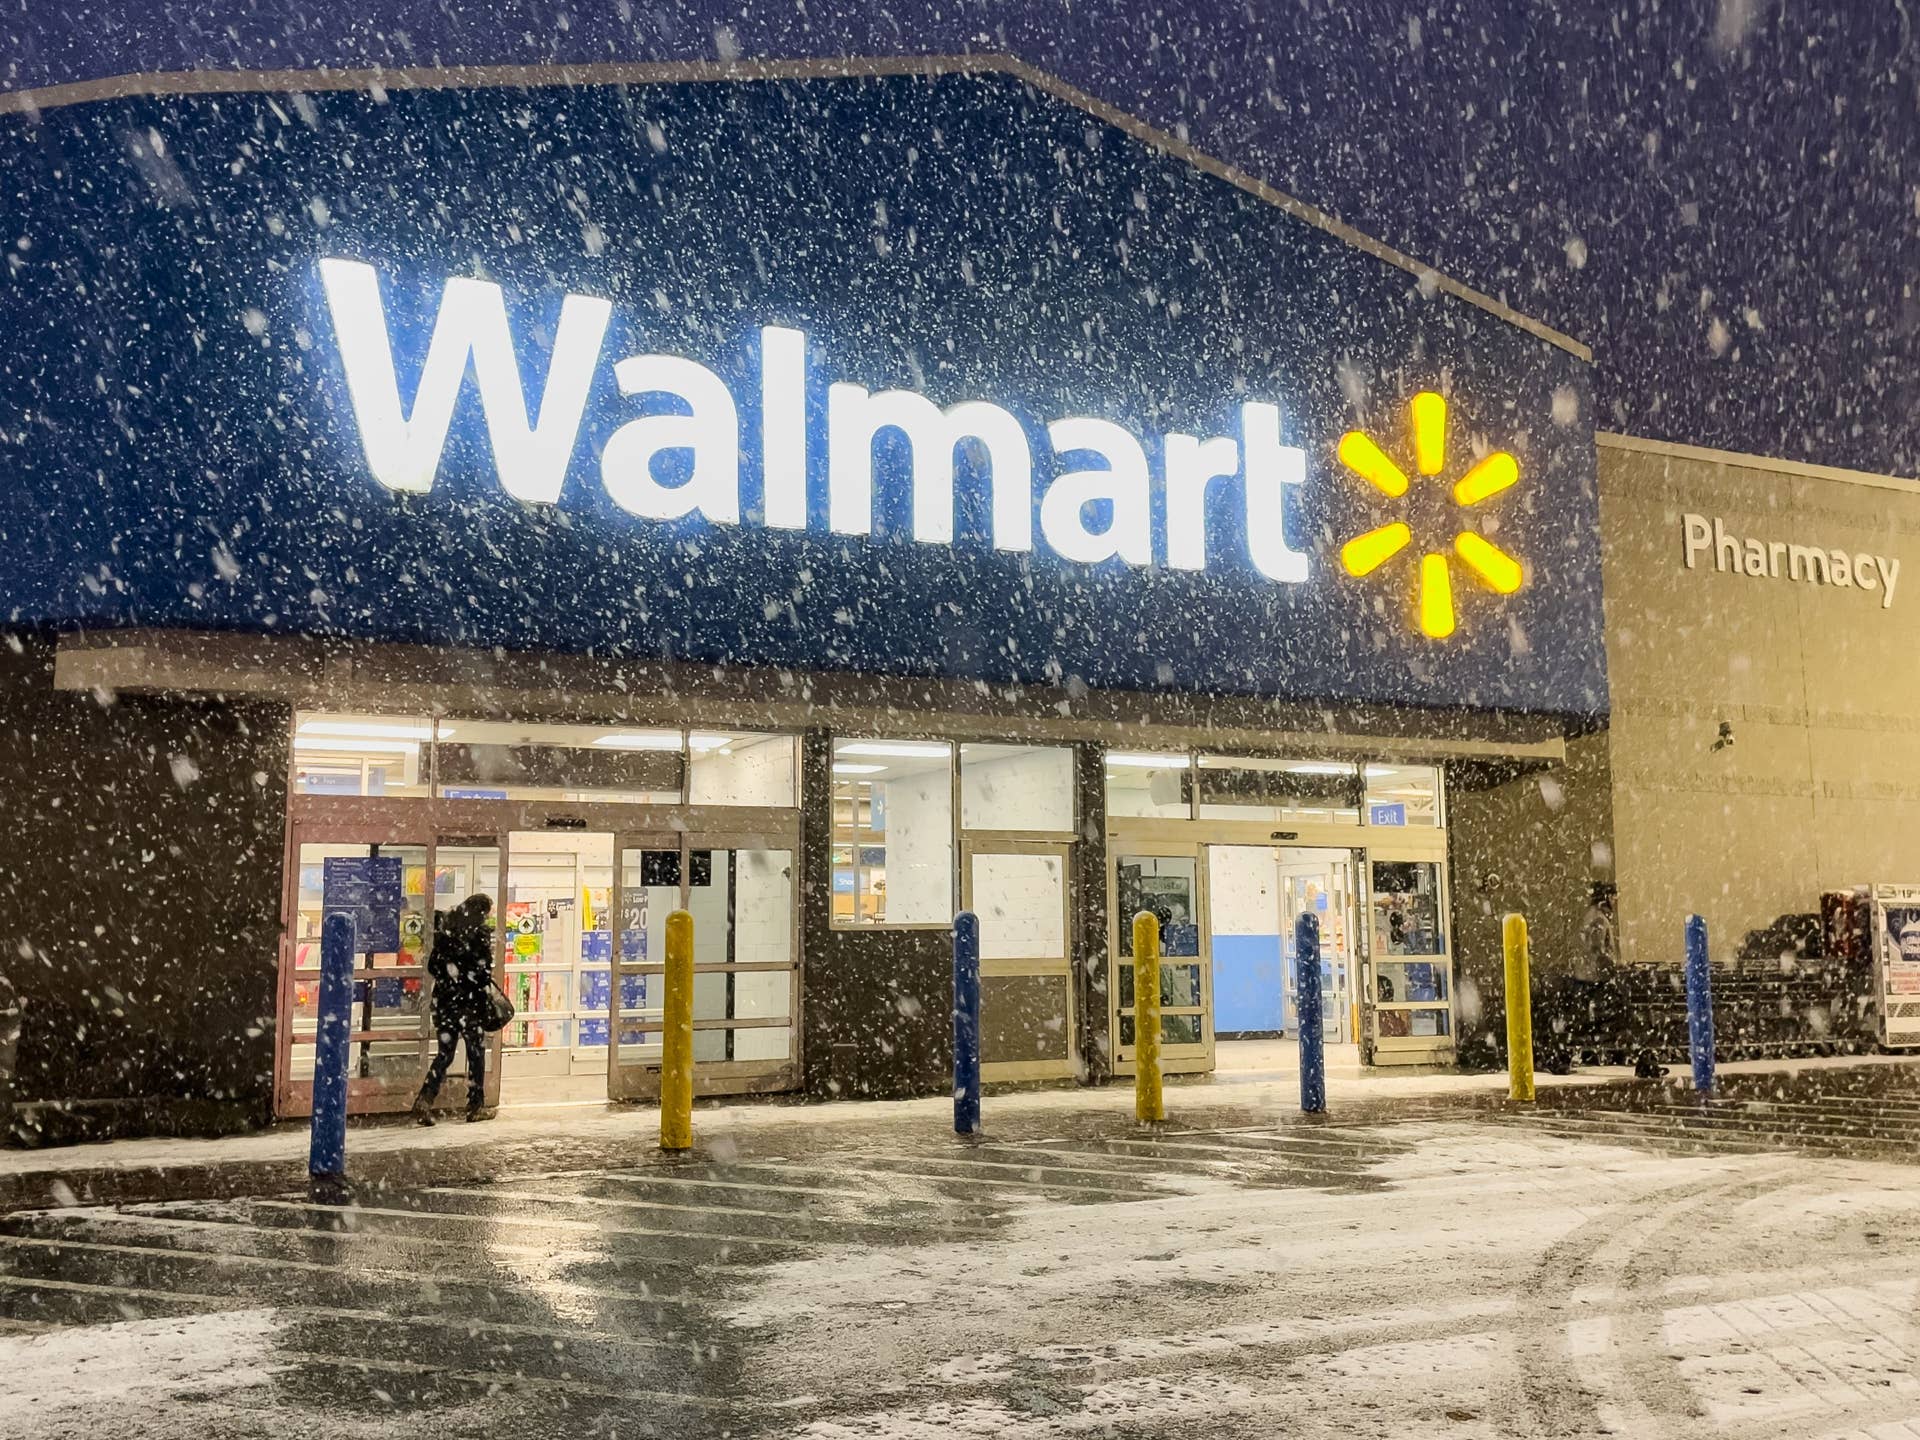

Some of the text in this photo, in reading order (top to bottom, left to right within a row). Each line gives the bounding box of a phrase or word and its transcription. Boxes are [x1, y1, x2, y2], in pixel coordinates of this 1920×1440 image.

[319, 258, 1312, 584] Walmart
[1682, 513, 1900, 609] Pharmacy
[1377, 808, 1398, 825] Exit
